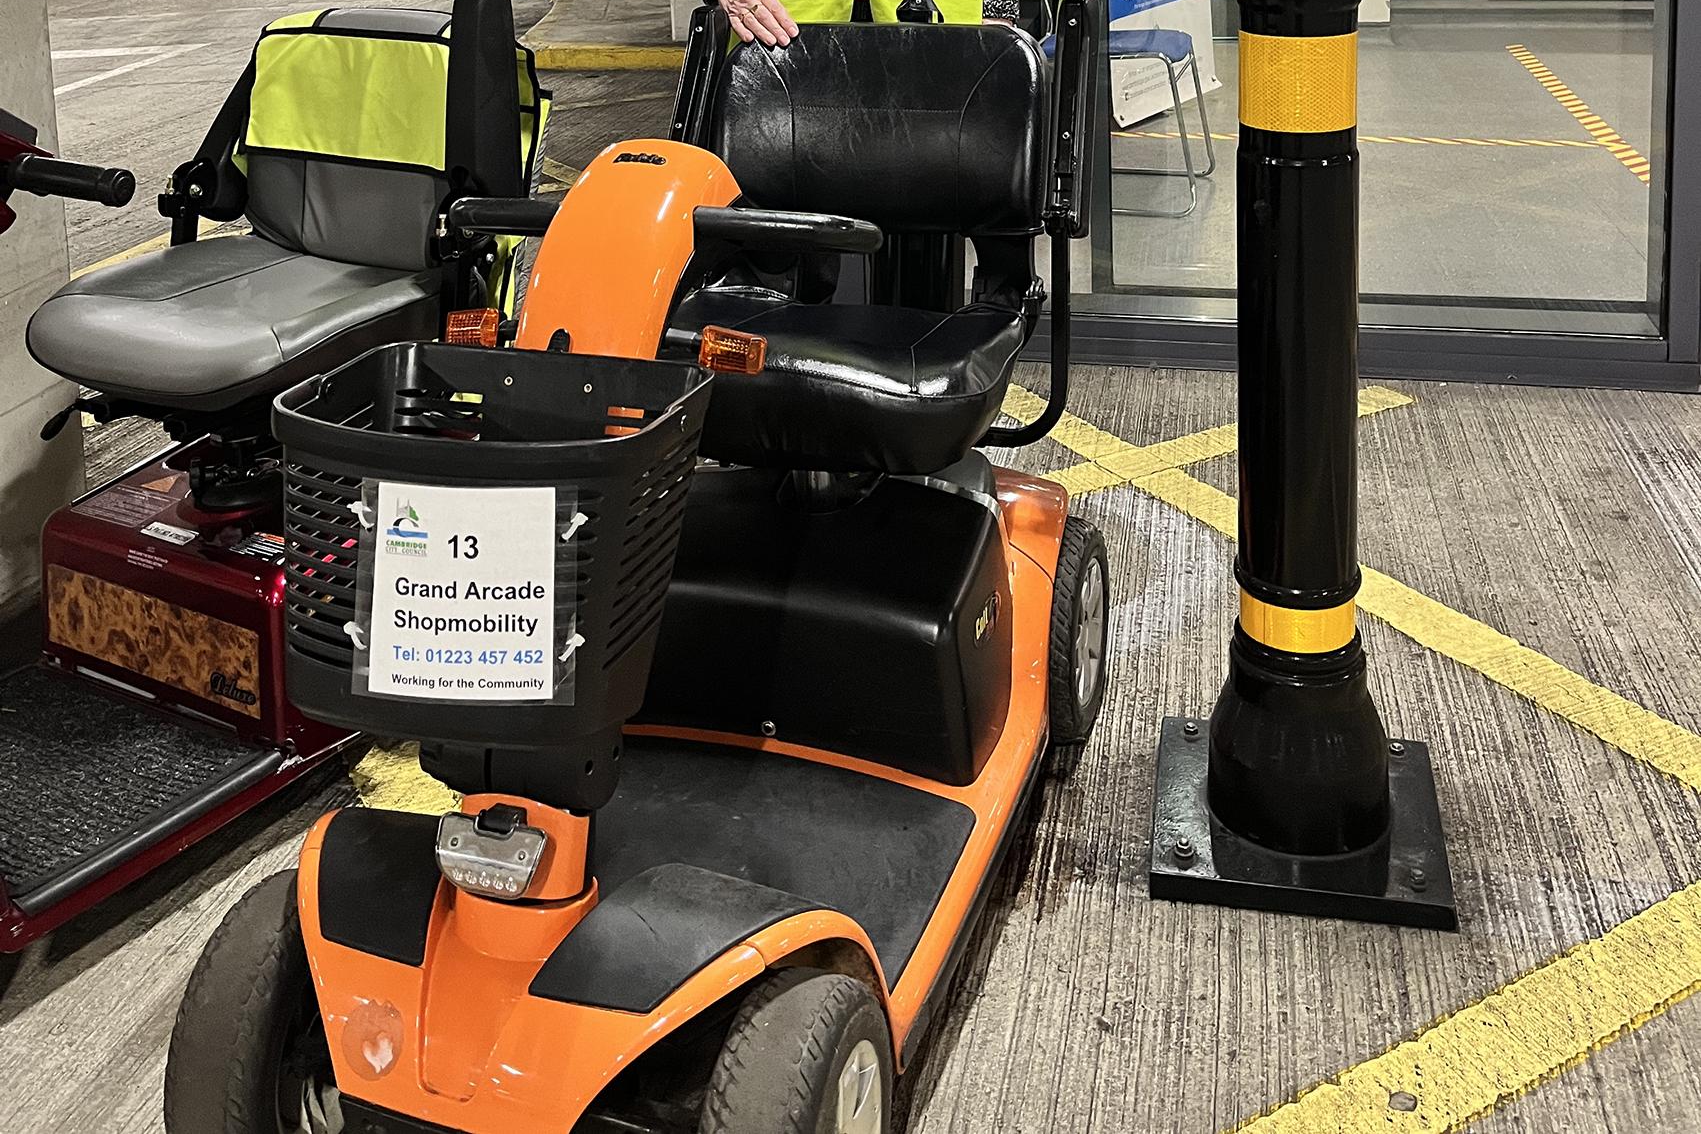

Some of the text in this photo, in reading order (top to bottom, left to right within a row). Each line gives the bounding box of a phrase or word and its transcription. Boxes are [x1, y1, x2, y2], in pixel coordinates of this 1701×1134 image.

[385, 546, 428, 557] CITY COUNCIL
[386, 540, 428, 550] CAMBRIDGE
[447, 534, 480, 559] 13
[395, 577, 545, 600] Grand Arcade
[394, 609, 538, 637] Shopmobility
[393, 645, 544, 665] Tel: 01223 457 452
[391, 674, 544, 691] Working for the Community
